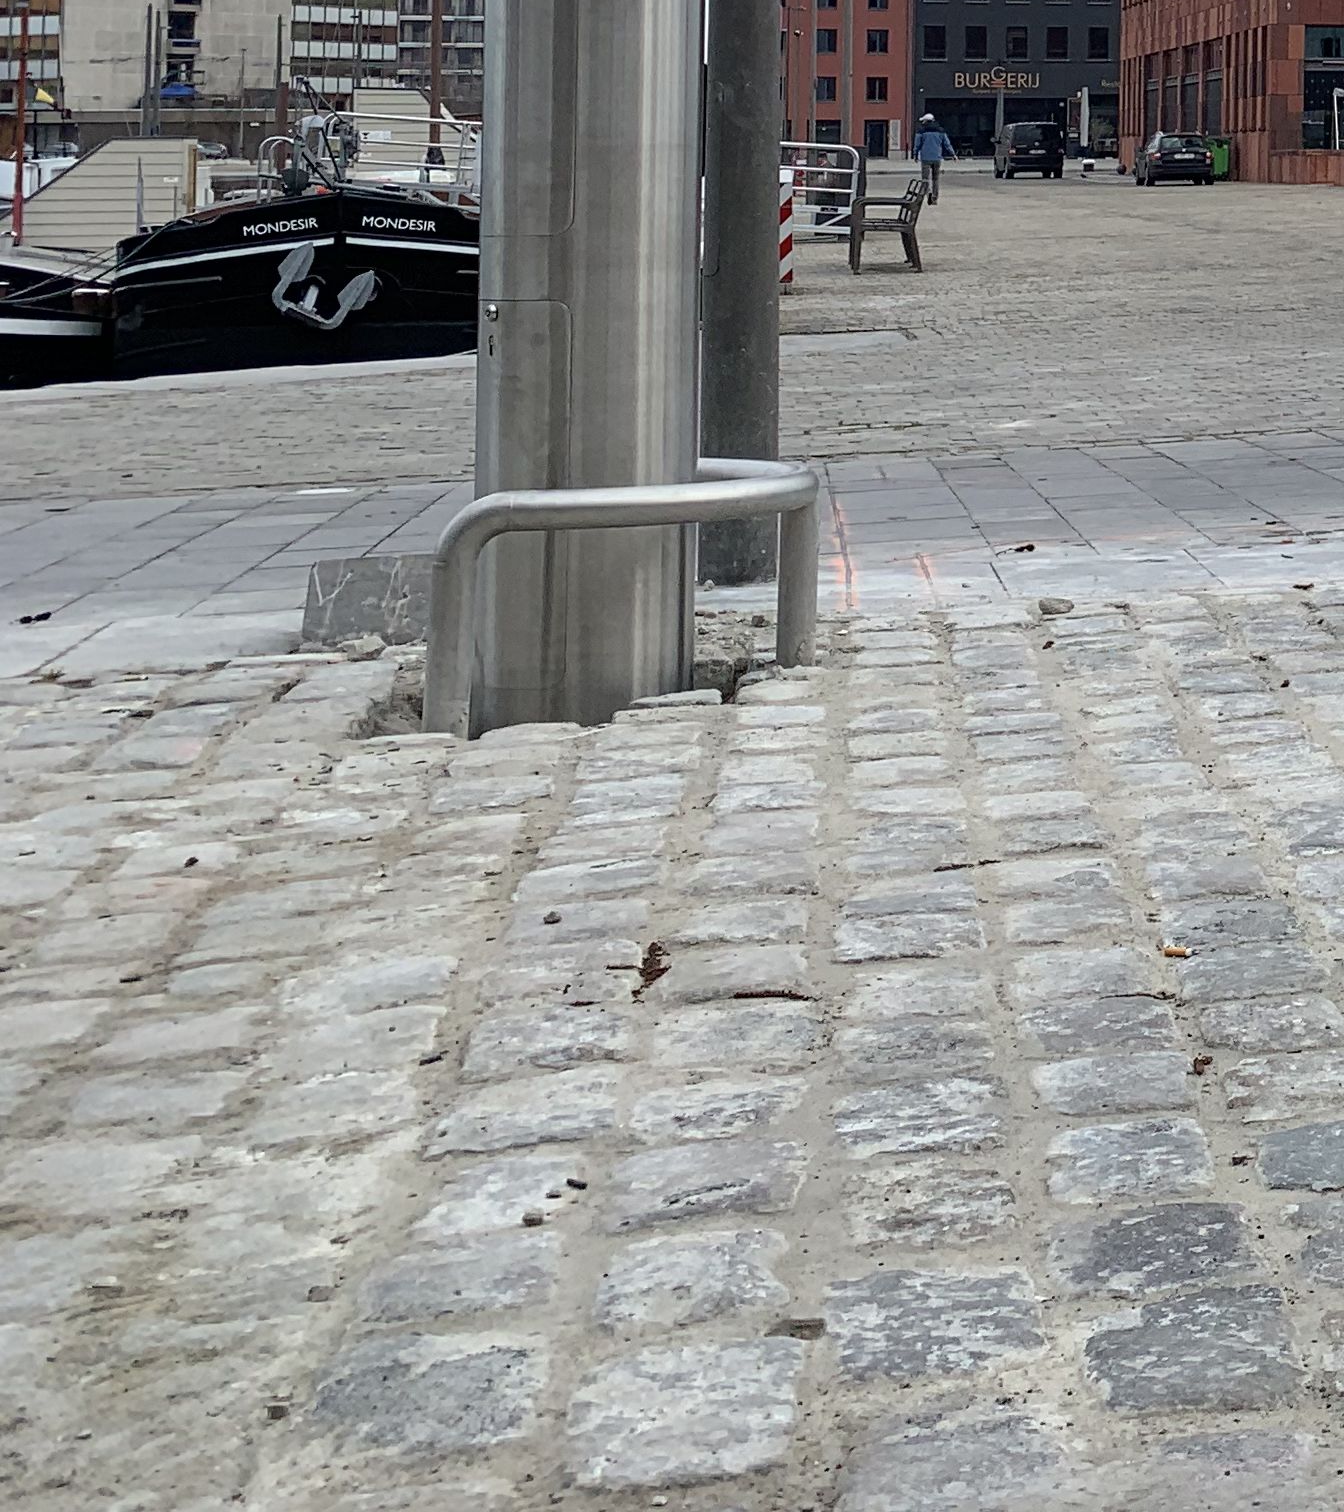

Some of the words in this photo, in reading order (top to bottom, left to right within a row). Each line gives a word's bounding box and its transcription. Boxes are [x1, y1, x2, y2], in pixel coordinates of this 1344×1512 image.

[955, 66, 1040, 88] BURGERIJ
[243, 217, 319, 236] MONDESIR
[362, 216, 436, 232] MONDESIR
